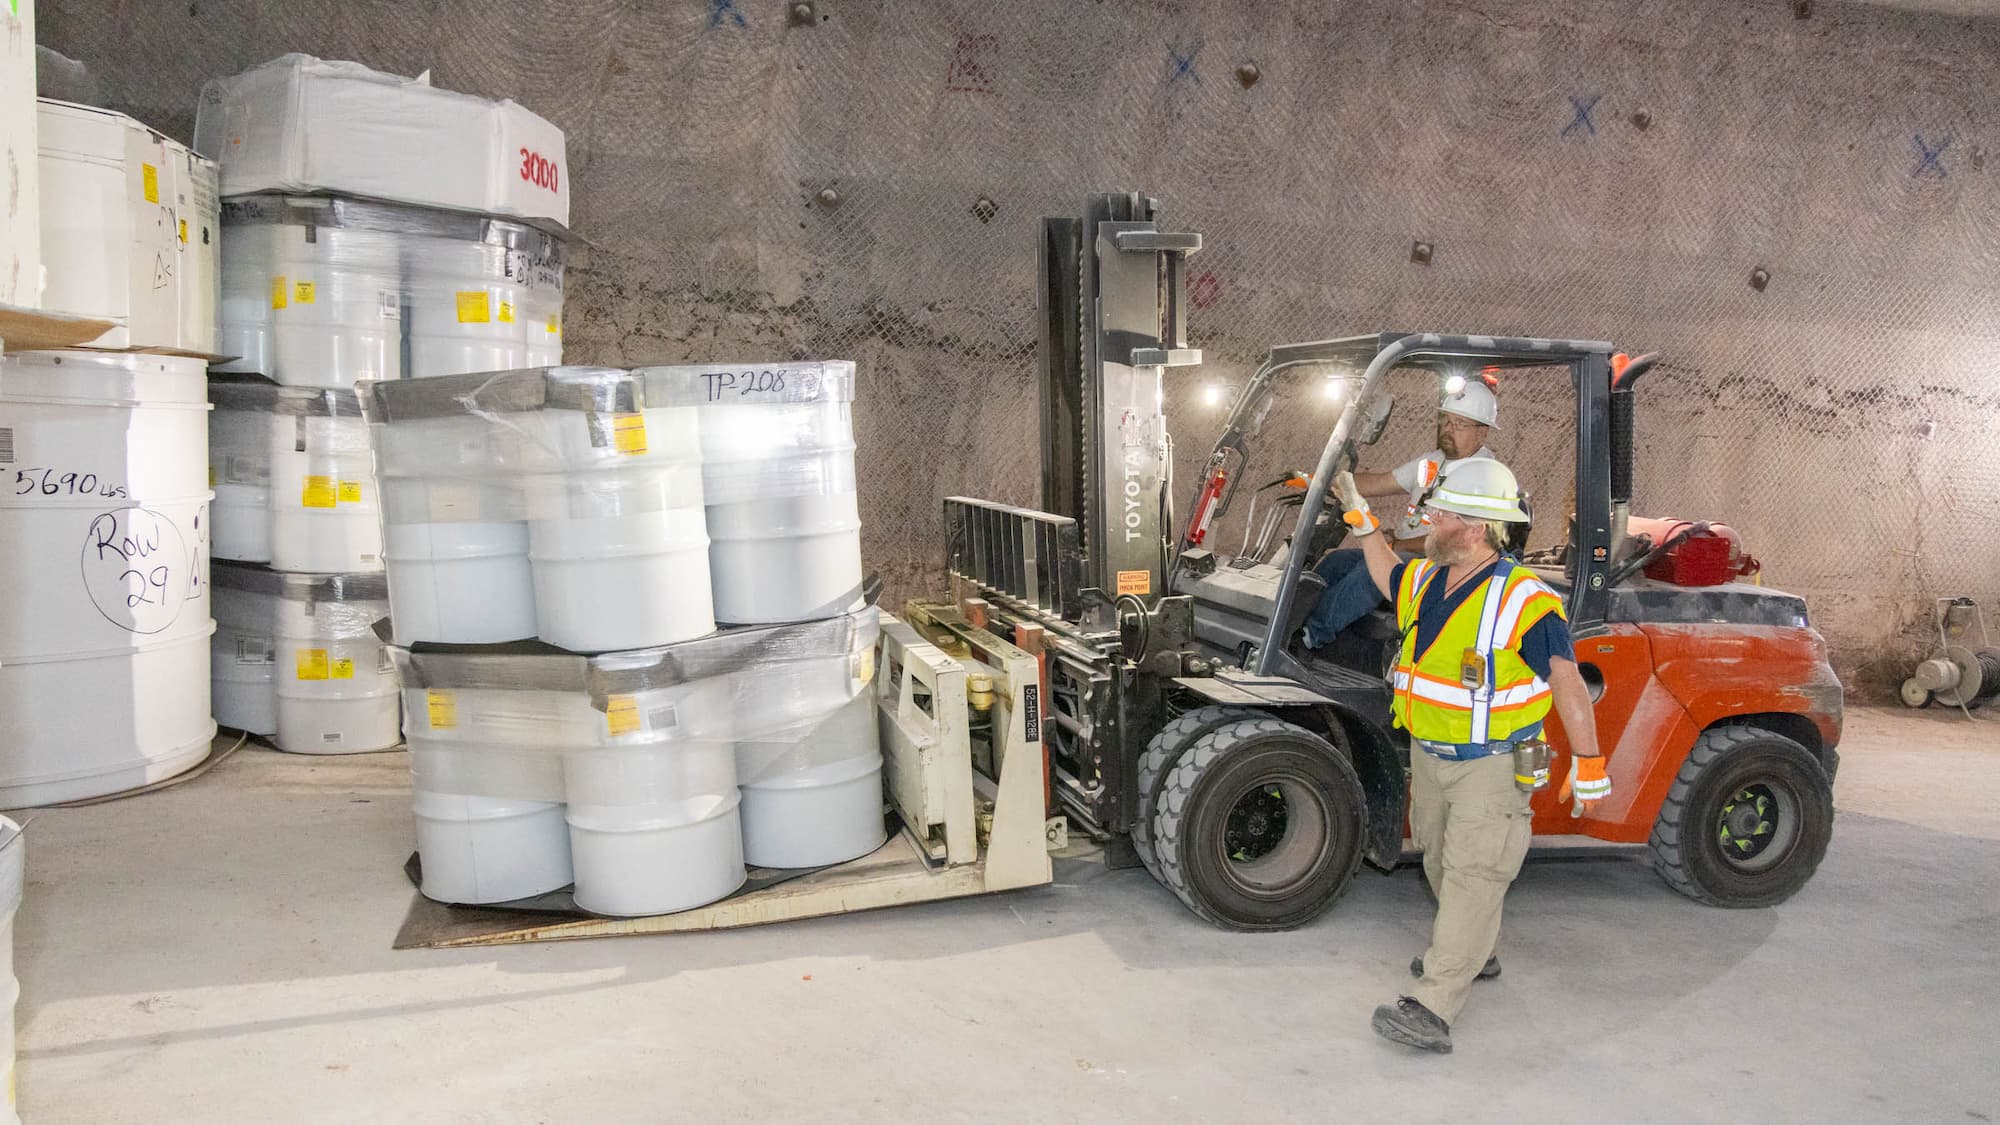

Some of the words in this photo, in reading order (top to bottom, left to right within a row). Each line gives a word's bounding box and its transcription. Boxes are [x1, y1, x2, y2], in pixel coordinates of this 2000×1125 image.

[519, 148, 558, 193] 3000
[700, 369, 787, 401] TP-208
[16, 469, 97, 495] 5690
[1125, 449, 1141, 543] TOYOTA
[119, 566, 168, 607] 29
